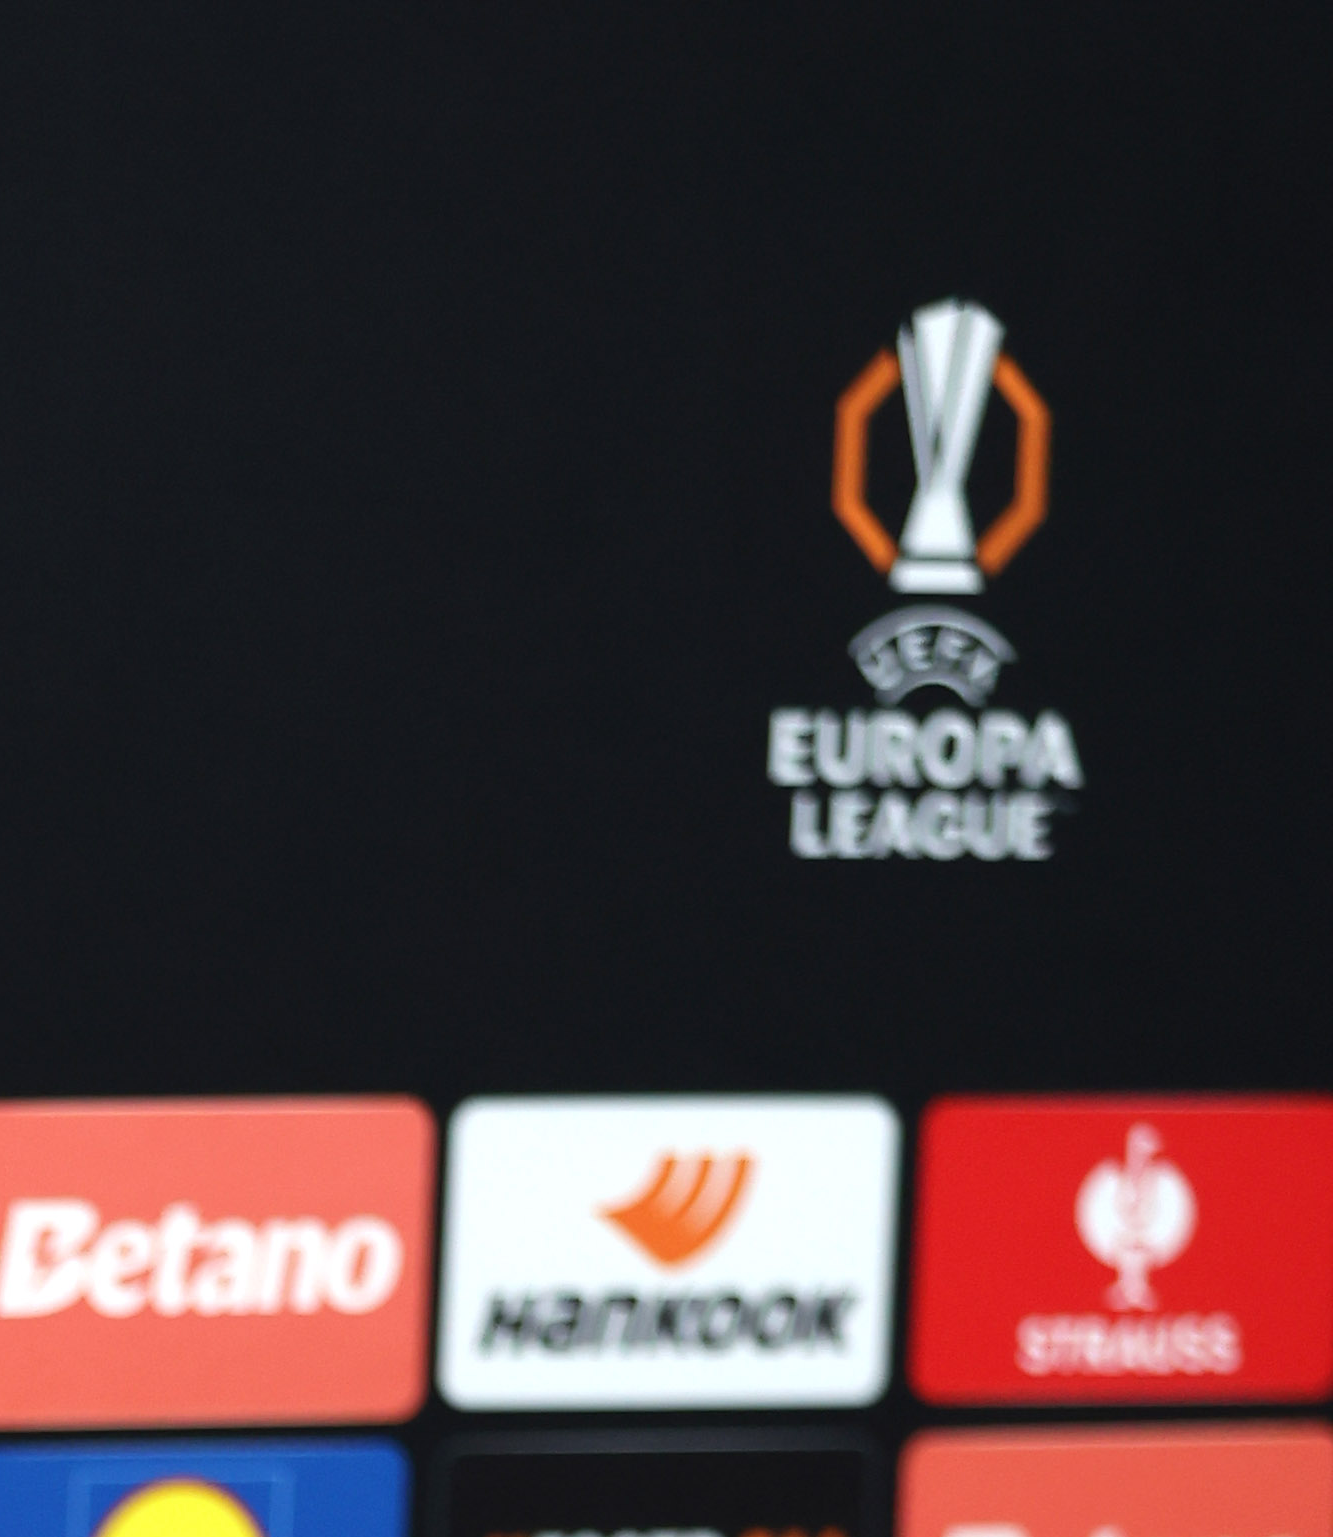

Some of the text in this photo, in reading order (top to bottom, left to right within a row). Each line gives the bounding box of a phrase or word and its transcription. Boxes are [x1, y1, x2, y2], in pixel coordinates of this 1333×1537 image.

[767, 710, 1082, 789] EUROPA
[789, 790, 1052, 860] LEAGUE
[1016, 1313, 1242, 1376] STRAUSS
